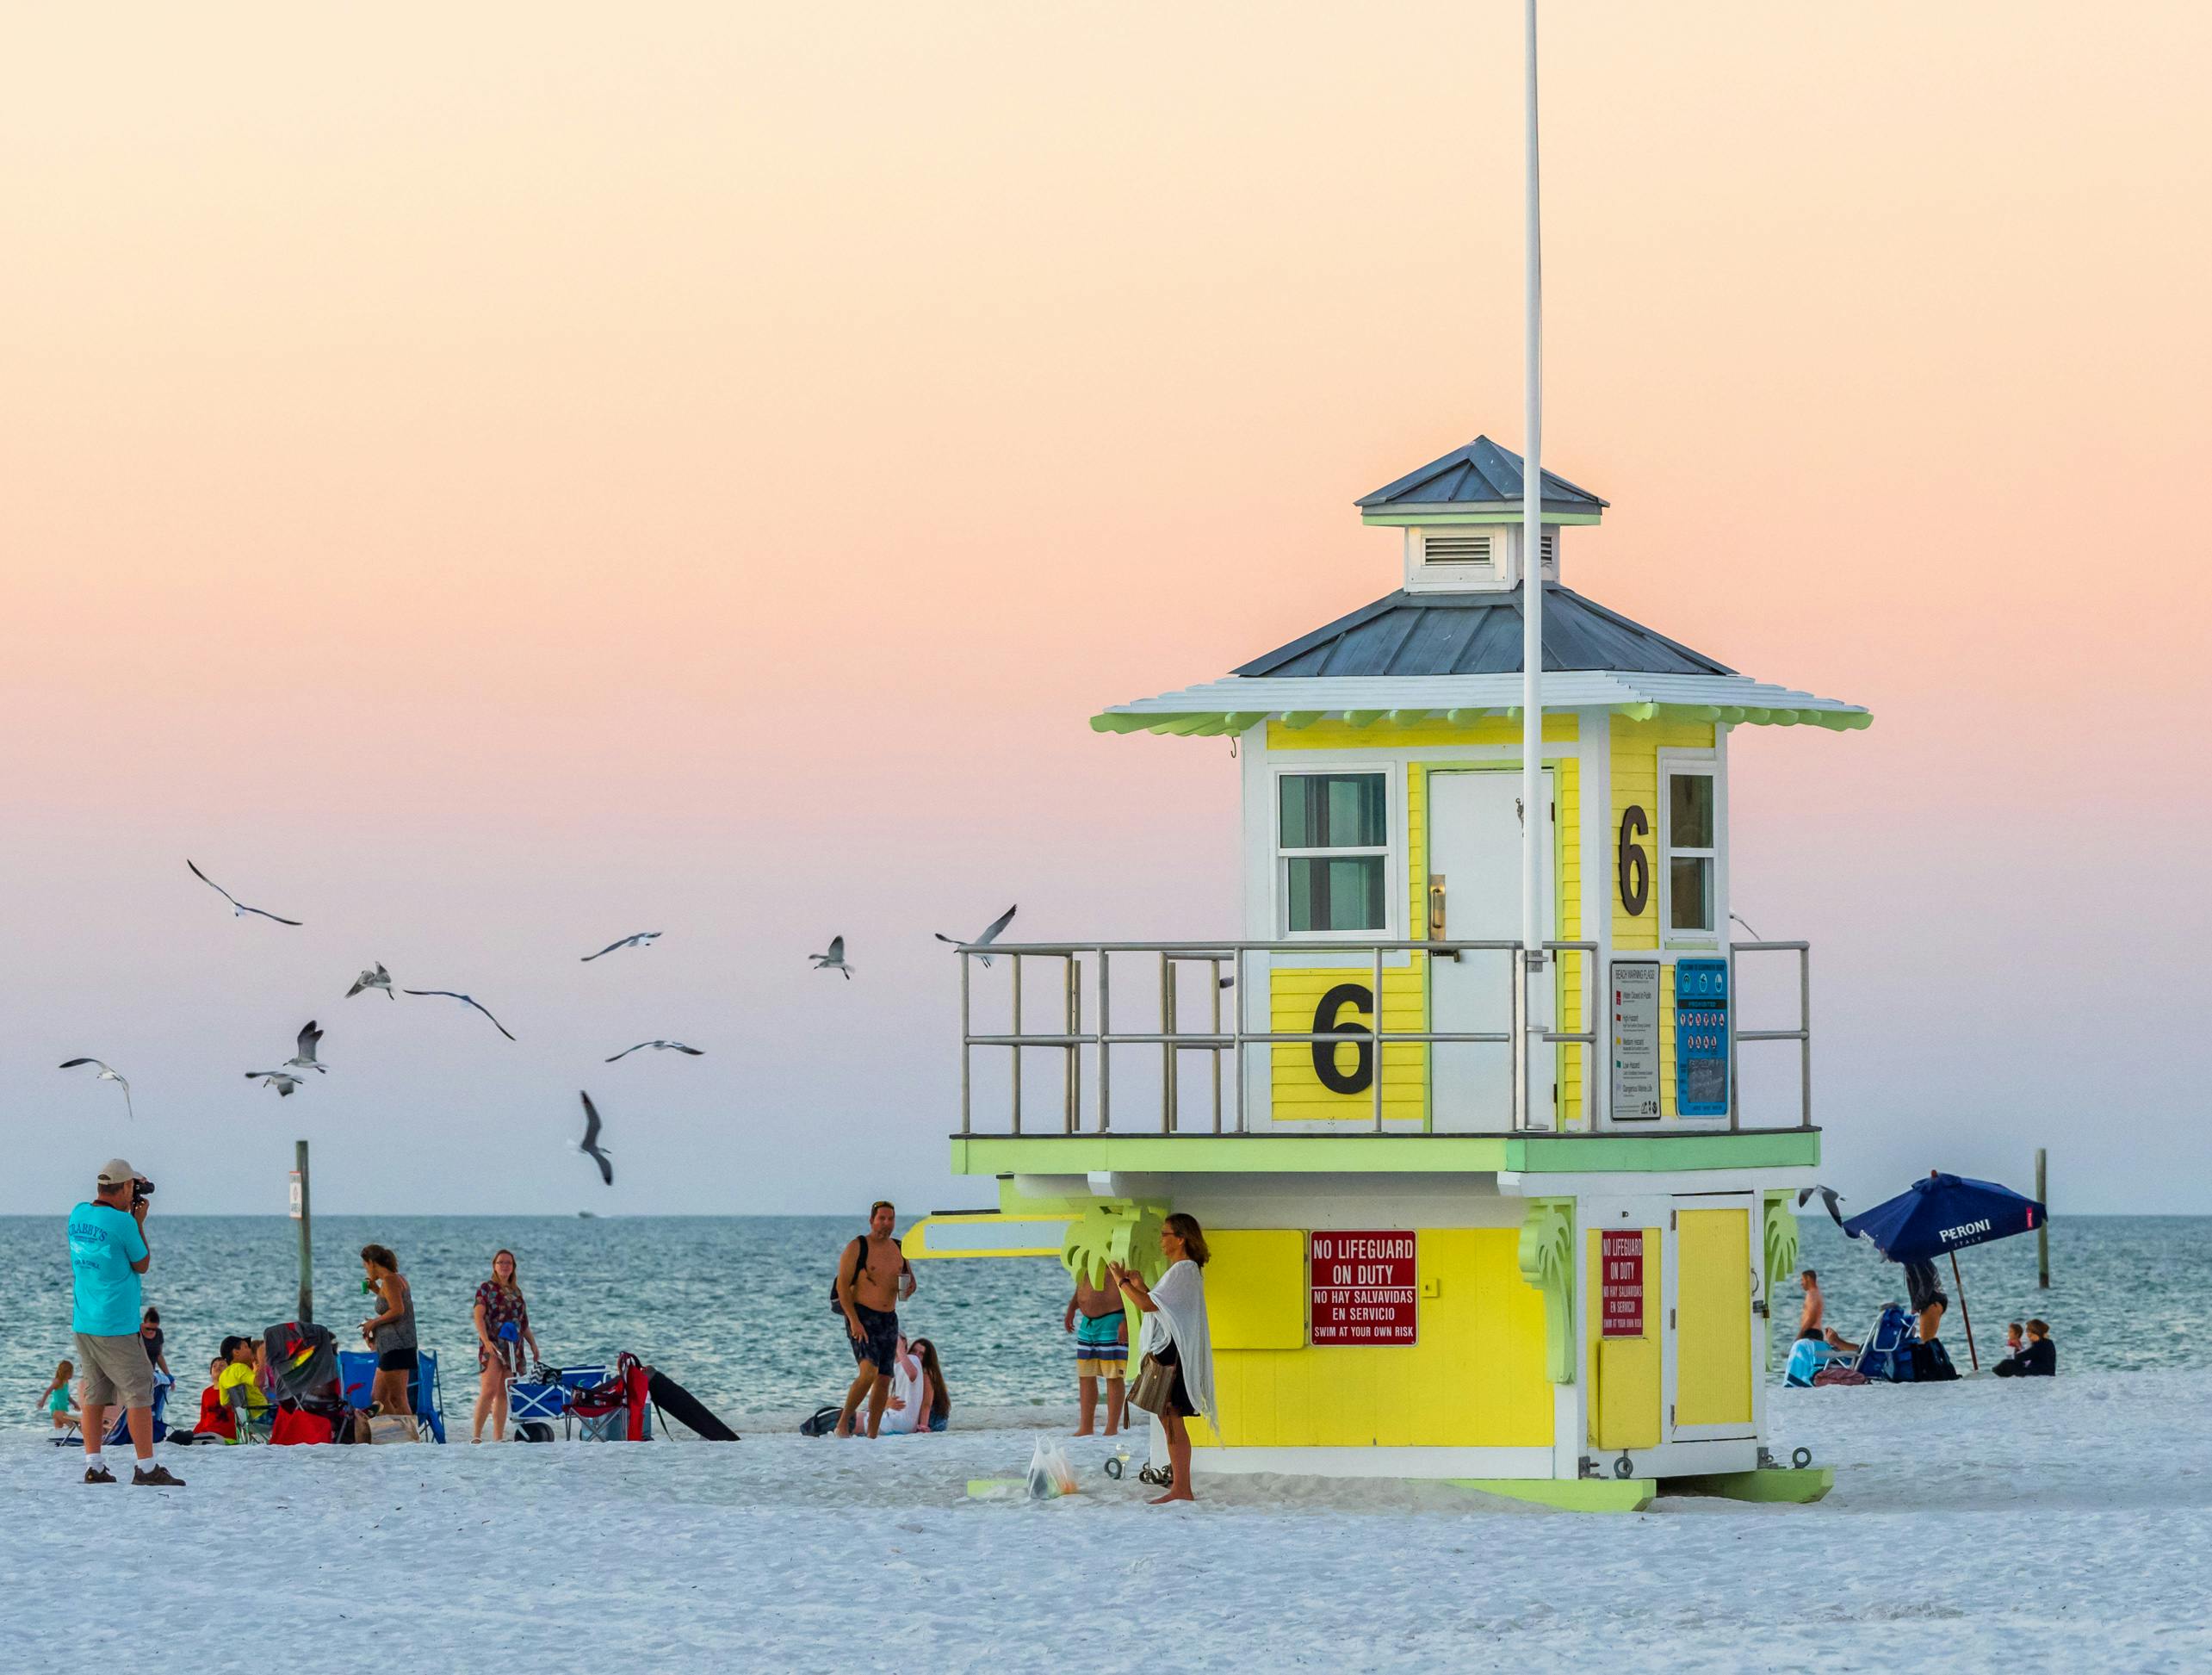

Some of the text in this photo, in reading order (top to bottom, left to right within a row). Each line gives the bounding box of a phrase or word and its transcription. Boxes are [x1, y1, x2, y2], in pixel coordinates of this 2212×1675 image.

[1619, 804, 1649, 916] 6
[1311, 983, 1374, 1095] 6
[1938, 1219, 1992, 1243] PERONI
[1313, 1239, 1413, 1259] NO LIFEGUARD
[1603, 1238, 1642, 1256] NO LIFEGUARD
[1954, 1236, 1981, 1247] ITALY
[1333, 1265, 1394, 1285] ON DUTY
[1610, 1262, 1634, 1280] ON DUTY
[1314, 1291, 1413, 1304] NO HAY SALVAVIDAS
[1609, 1285, 1618, 1298] HAY
[1332, 1307, 1395, 1321] EN SERVICIO
[1610, 1301, 1616, 1312] EN
[1314, 1326, 1414, 1337] SWIM AT YOUR OWN RISK
